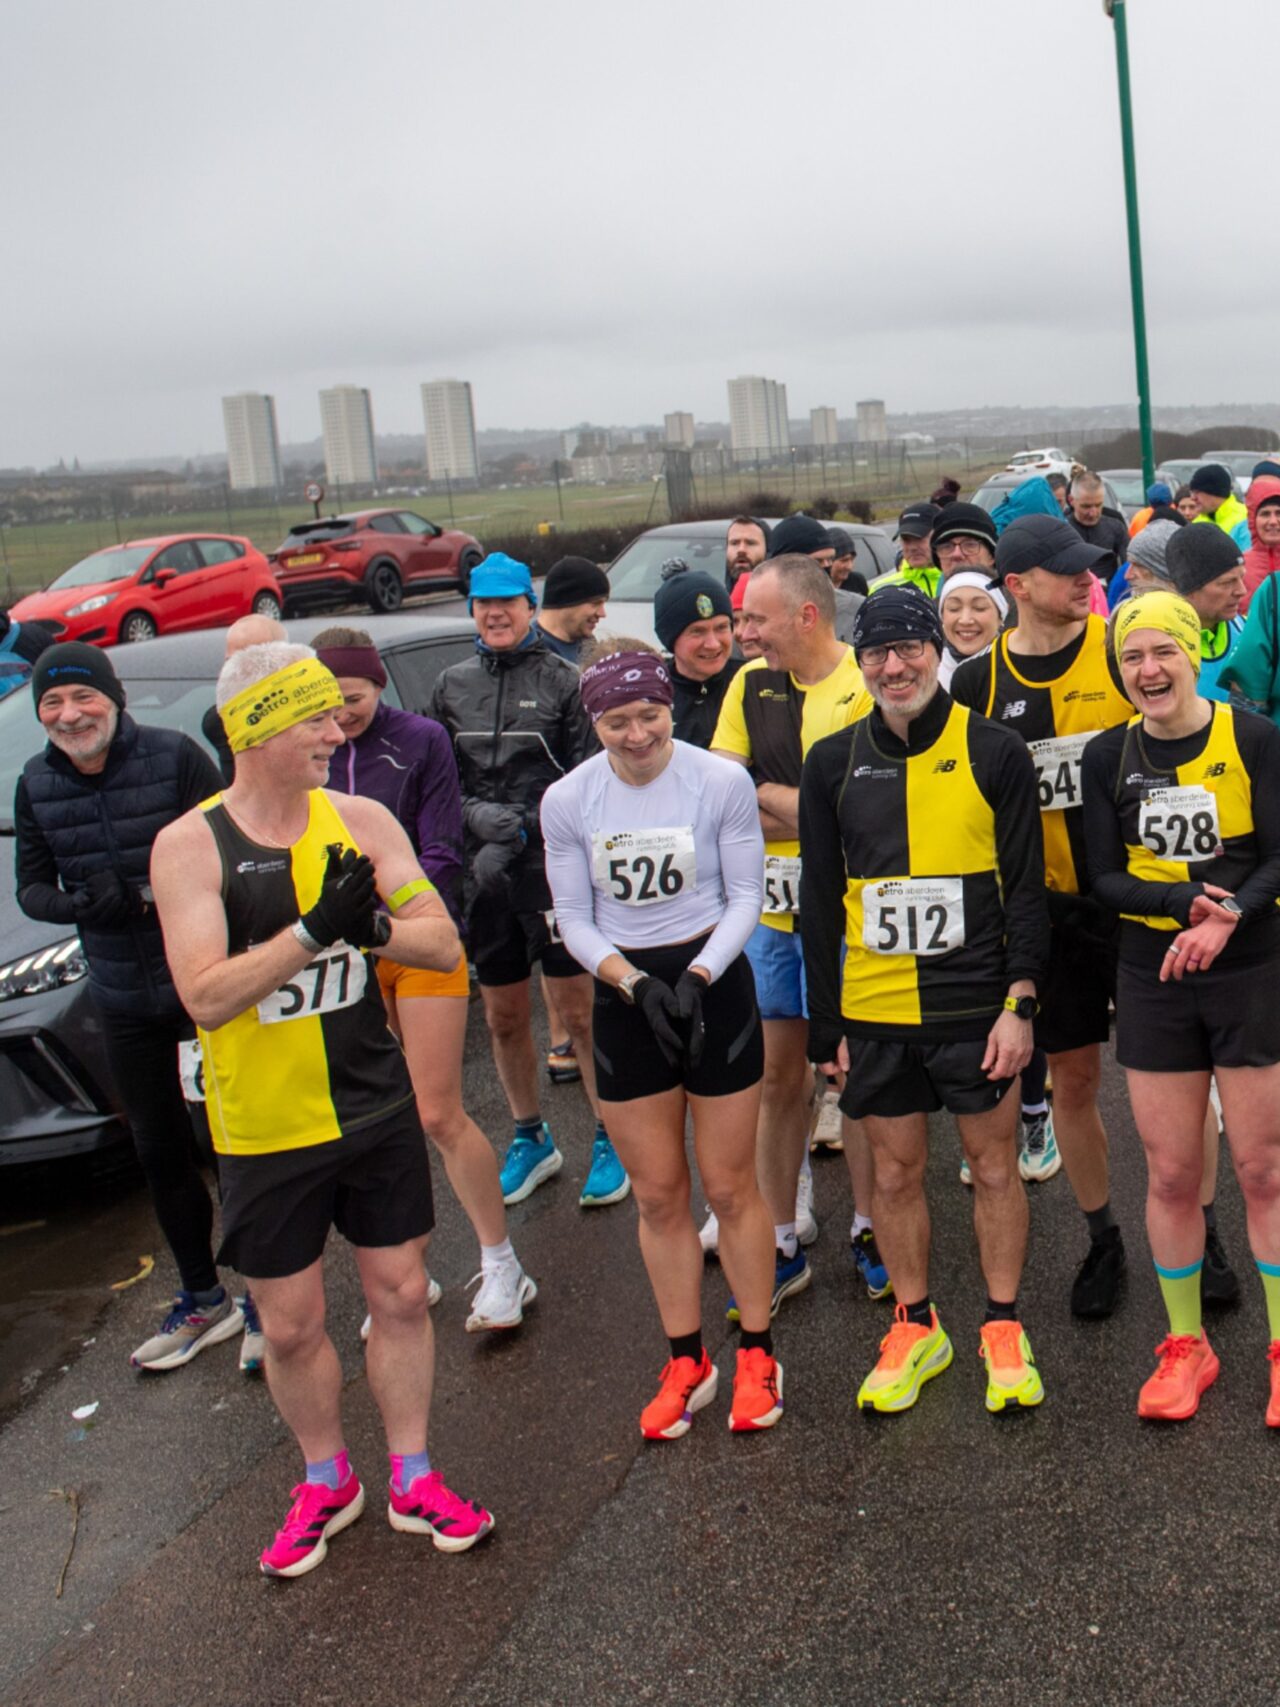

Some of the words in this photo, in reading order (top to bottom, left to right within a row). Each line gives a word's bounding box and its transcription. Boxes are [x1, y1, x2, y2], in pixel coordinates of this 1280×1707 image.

[1035, 759, 1082, 807] 64
[1144, 811, 1217, 856] 528
[609, 853, 684, 901] 526
[905, 886, 945, 895] aberdeen
[878, 904, 948, 951] 512
[277, 952, 350, 1016] 577
